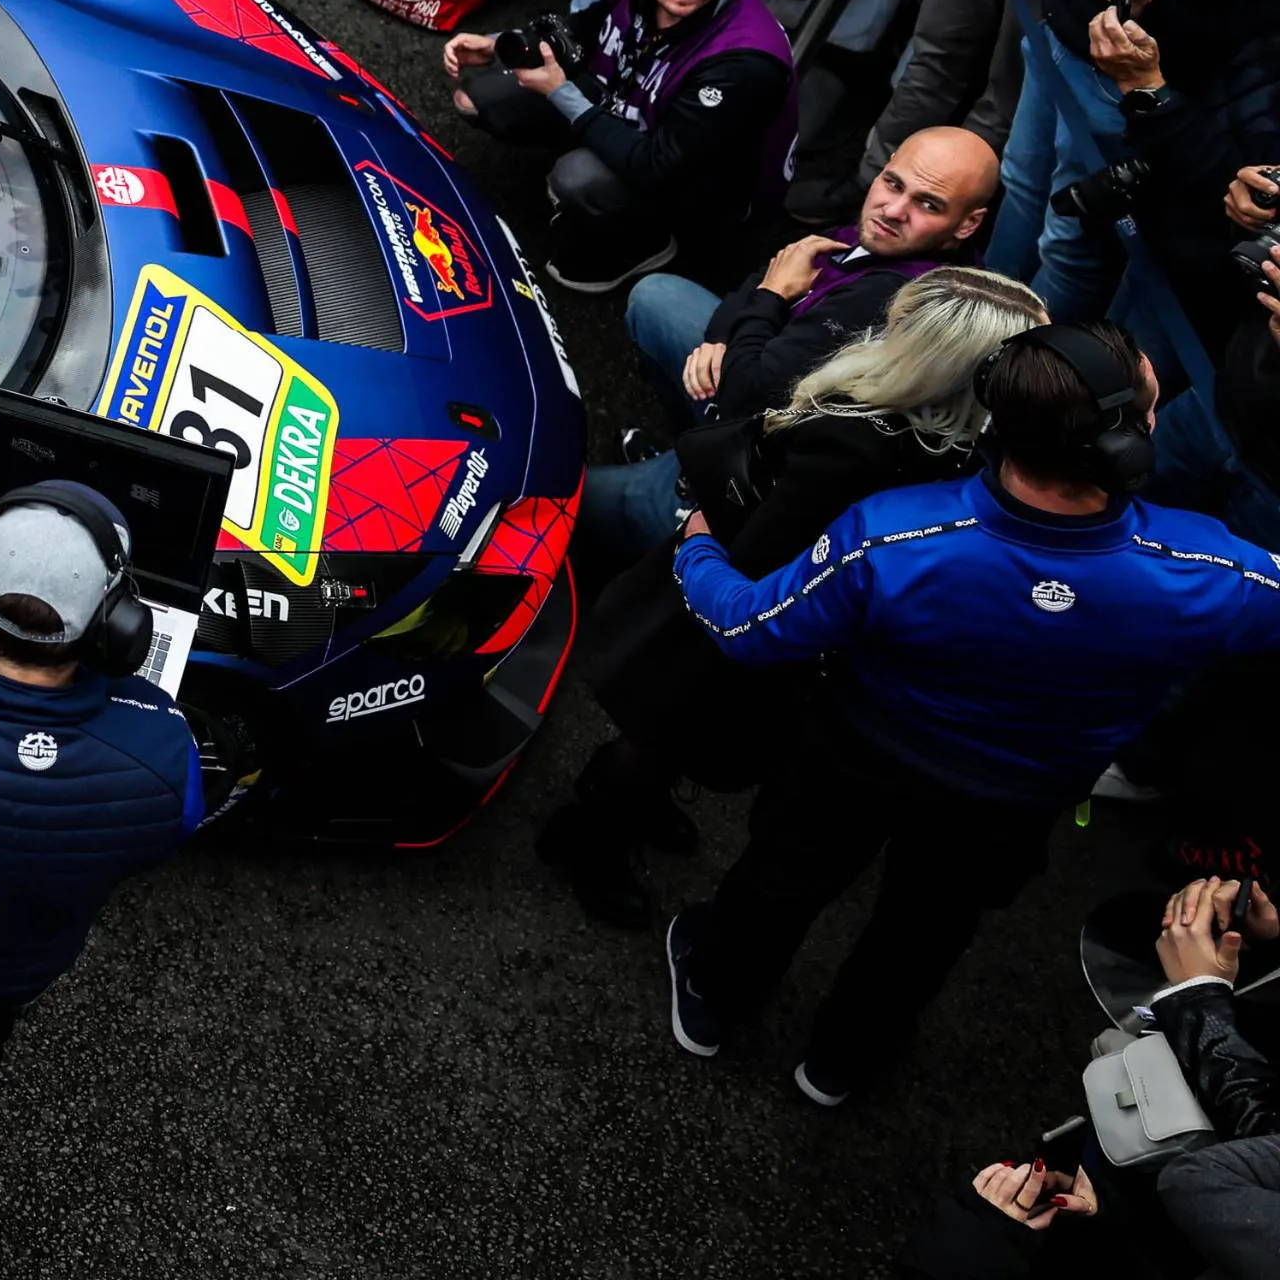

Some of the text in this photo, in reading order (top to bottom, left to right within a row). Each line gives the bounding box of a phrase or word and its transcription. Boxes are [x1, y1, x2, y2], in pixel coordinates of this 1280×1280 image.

[364, 171, 424, 304] VERSTAPPEN.COM
[391, 212, 419, 267] RACING
[118, 302, 175, 430] AVENOL
[273, 405, 328, 510] DEKRA
[202, 587, 290, 622] KEN
[326, 672, 425, 724] sparco
